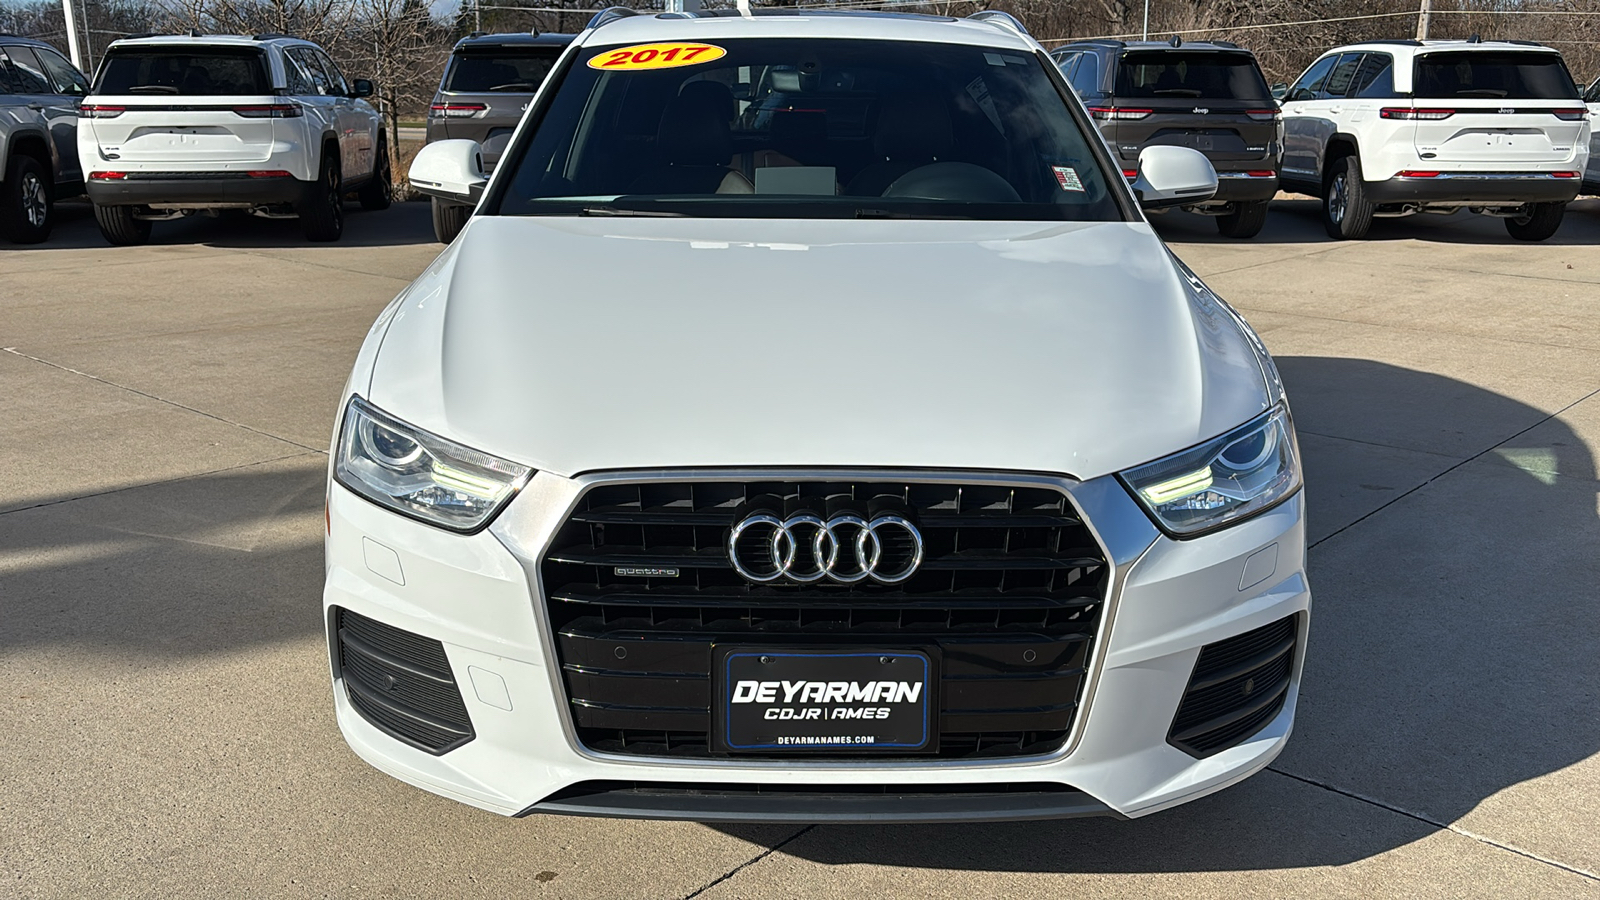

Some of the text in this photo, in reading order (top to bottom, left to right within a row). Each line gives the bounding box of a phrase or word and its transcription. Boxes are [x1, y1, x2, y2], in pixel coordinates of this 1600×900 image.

[601, 47, 711, 67] 2017
[1192, 106, 1209, 115] Jeep
[731, 680, 923, 703] DEYARMAN
[764, 707, 891, 720] CDJR AMES
[777, 735, 875, 745] DEYARMANAMES.COM
